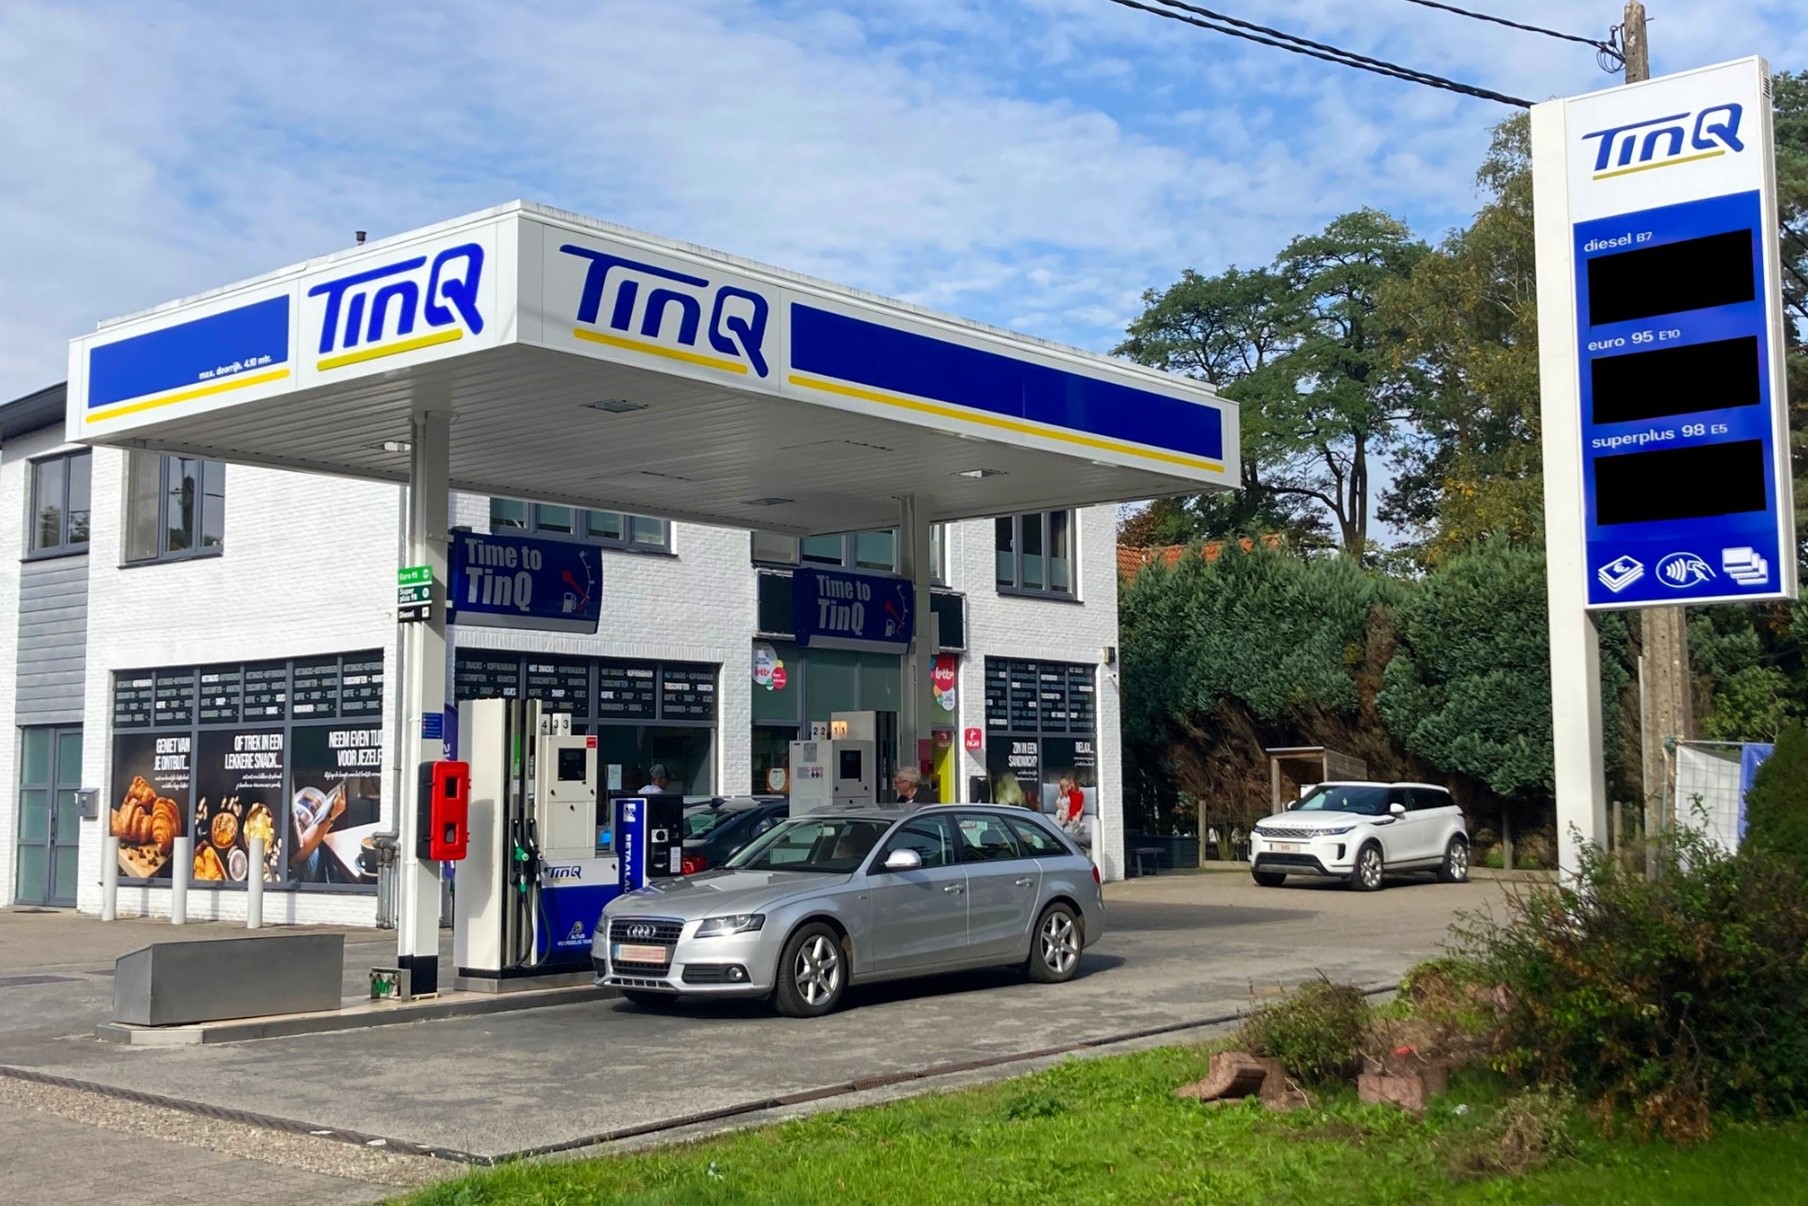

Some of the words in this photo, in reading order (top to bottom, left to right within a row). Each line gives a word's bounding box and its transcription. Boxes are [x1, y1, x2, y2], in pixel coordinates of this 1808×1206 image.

[1581, 102, 1744, 171] TinQ
[1584, 232, 1632, 252] diesel
[1636, 231, 1653, 242] B7
[308, 243, 484, 354] TinQ
[559, 244, 768, 378] TinQ
[1588, 337, 1625, 351] euro
[1631, 330, 1654, 344] 95
[1659, 328, 1680, 341] E10
[199, 370, 215, 380] max.
[1592, 428, 1675, 449] superplus
[1681, 423, 1705, 438] 98
[1711, 423, 1728, 435] E5
[465, 538, 518, 568] Time
[521, 546, 542, 571] to
[466, 567, 532, 612] TinQ
[816, 574, 854, 599] Time
[855, 580, 871, 602] to
[818, 598, 865, 636] TinQ
[935, 666, 954, 680] lotto
[541, 720, 548, 730] 4
[553, 719, 559, 730] 3
[562, 719, 569, 730] 3
[813, 726, 818, 736] 2
[820, 726, 826, 736] 2
[177, 737, 190, 753] VAN
[234, 735, 244, 751] OF
[244, 734, 261, 751] TREK
[261, 734, 269, 751] IN
[269, 734, 284, 750] EEN
[328, 730, 350, 748] NEEM
[350, 730, 370, 747] EVEN
[1012, 742, 1022, 754] ZIN
[1027, 742, 1038, 754] EEN
[153, 755, 161, 771] JE
[224, 752, 254, 770] LEKKERE
[337, 749, 357, 767] VOOR
[1008, 755, 1038, 768] SANDWICH?
[545, 865, 582, 880] TinQ
